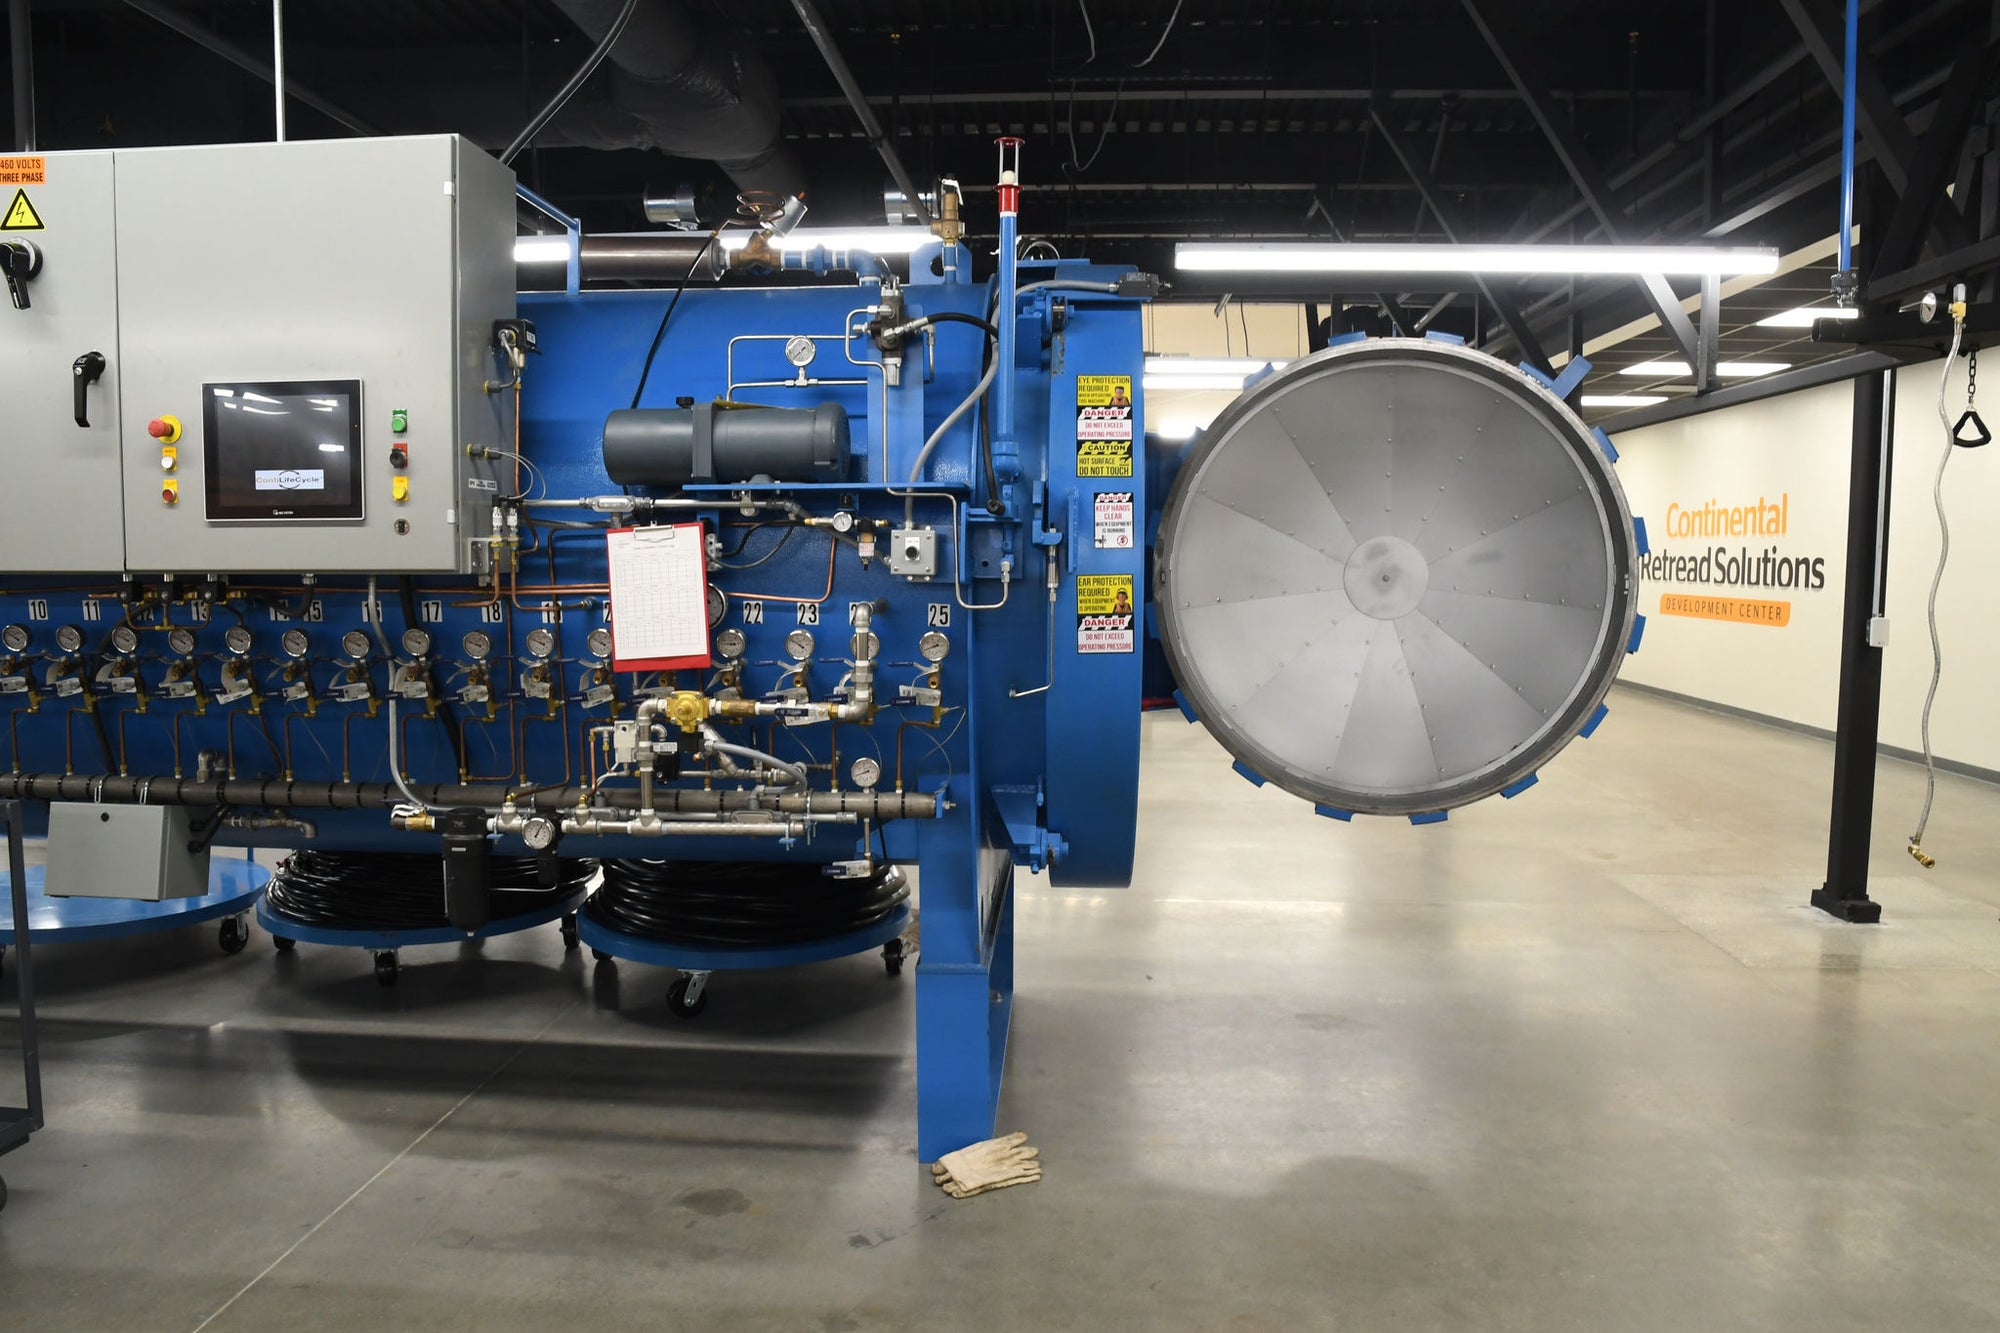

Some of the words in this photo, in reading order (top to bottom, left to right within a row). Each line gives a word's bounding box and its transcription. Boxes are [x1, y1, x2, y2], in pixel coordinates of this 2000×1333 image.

[0, 159, 14, 169] 460
[16, 159, 41, 169] VOLTS
[0, 173, 19, 182] THREE
[21, 172, 44, 182] PHASE
[1079, 466, 1089, 475] DO
[1090, 466, 1104, 475] NOT
[1106, 466, 1129, 475] TOUCH
[256, 476, 320, 484] ContiLifeCycle
[1666, 493, 1788, 538] Continental
[1078, 577, 1091, 586] EAR
[1092, 577, 1132, 586] PROTECTION
[1078, 587, 1111, 597] REQUIRED
[31, 601, 46, 619] 10
[85, 601, 98, 620] 11
[424, 602, 440, 621] 17
[486, 601, 500, 621] 18
[744, 602, 761, 624] 22
[799, 603, 817, 625] 23
[929, 604, 948, 627] 25
[1666, 597, 1734, 616] DEVELOPMENT
[1739, 603, 1782, 621] CENTER
[1084, 618, 1125, 626] DANGER
